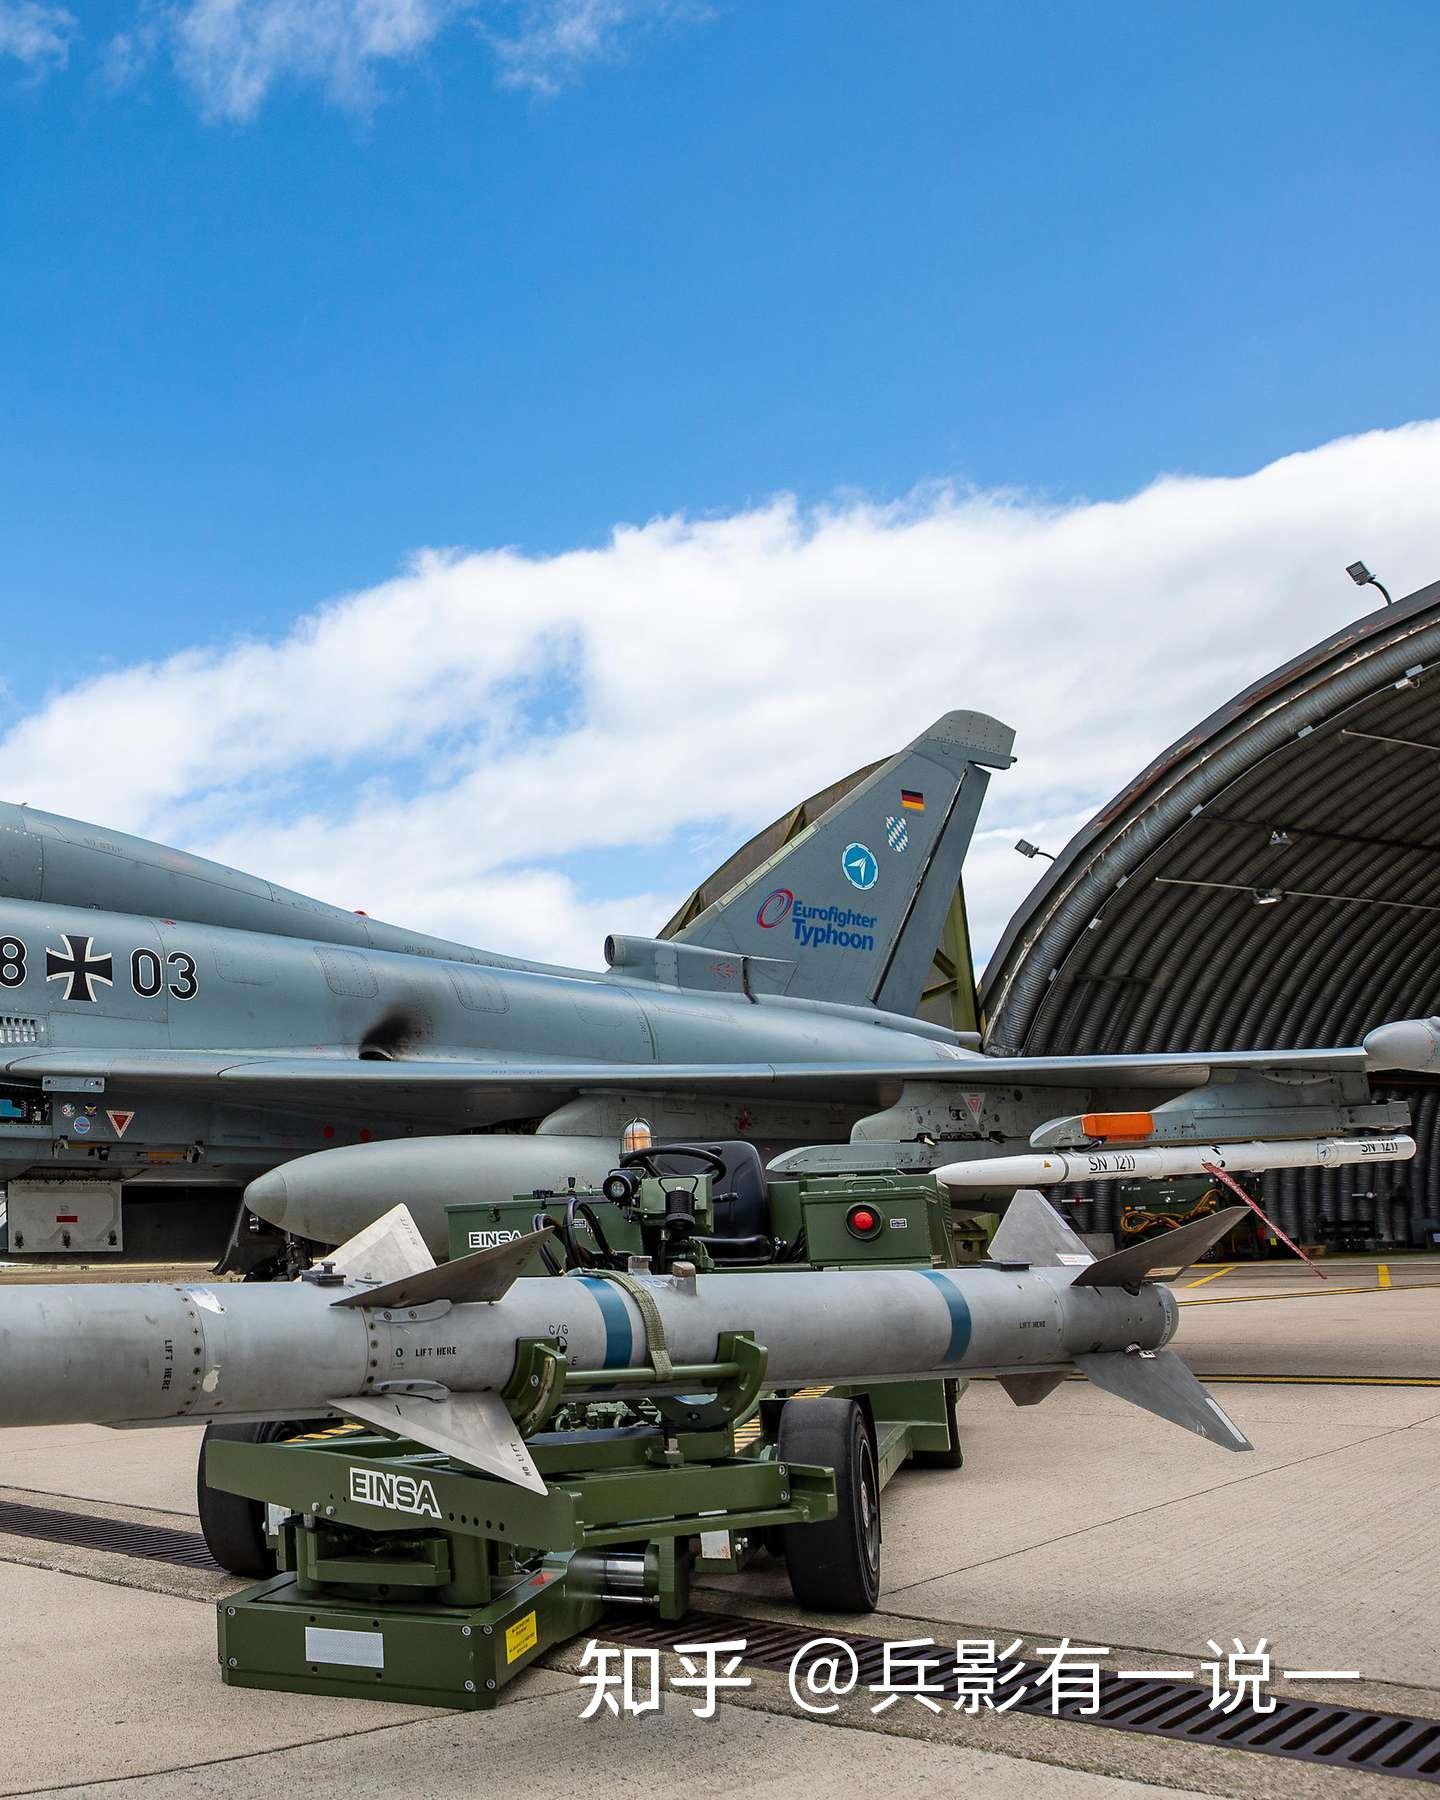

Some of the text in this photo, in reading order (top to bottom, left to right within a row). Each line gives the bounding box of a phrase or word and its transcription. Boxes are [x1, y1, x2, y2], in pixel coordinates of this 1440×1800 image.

[792, 900, 878, 928] Eurofighter
[792, 918, 874, 951] Typhoon
[130, 947, 198, 1000] 03
[1088, 1154, 1135, 1171] SN 1211
[548, 1324, 569, 1336] C/G
[161, 1339, 173, 1391] LIFT HERE
[415, 1346, 457, 1358] LIFT HERE
[349, 1467, 442, 1519] EINSA
